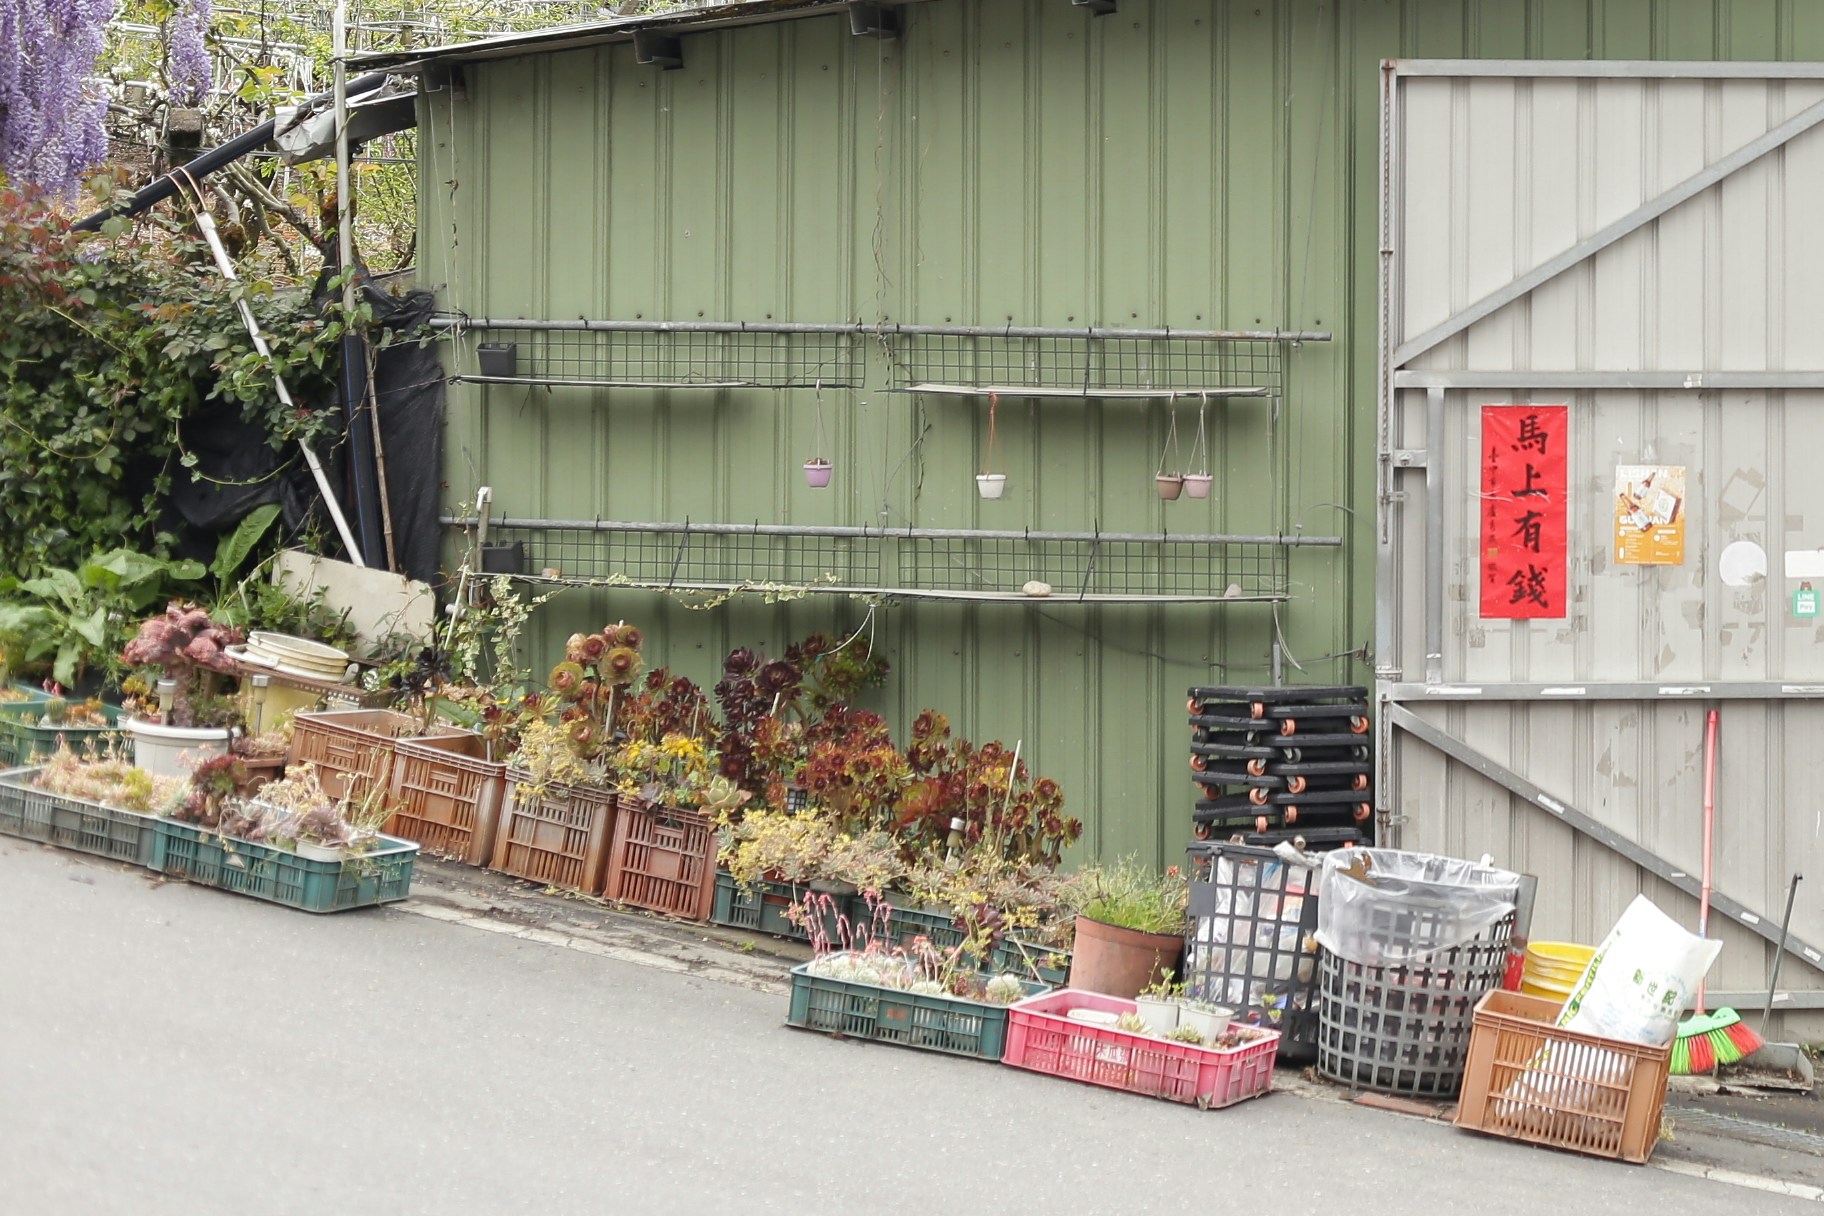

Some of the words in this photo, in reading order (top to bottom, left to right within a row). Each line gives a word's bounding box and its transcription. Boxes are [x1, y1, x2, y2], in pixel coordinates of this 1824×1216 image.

[1506, 414, 1549, 609] 馬上有錢
[1797, 593, 1815, 601] LINE
